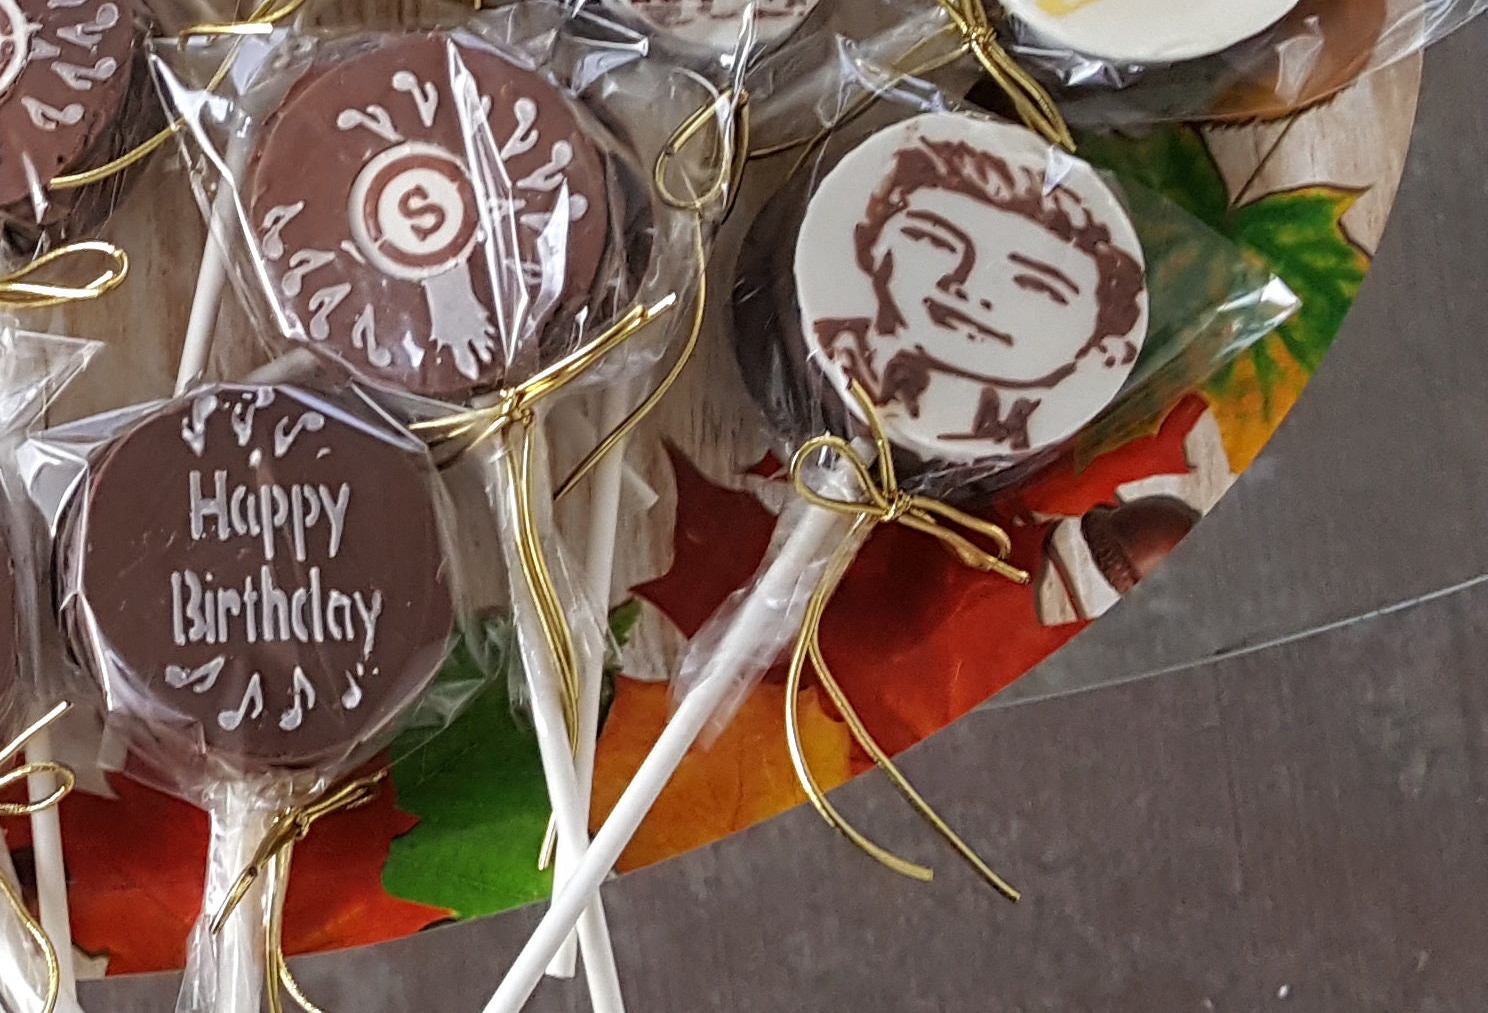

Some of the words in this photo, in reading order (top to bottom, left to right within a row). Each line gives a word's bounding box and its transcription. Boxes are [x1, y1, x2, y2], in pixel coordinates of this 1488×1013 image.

[397, 183, 447, 242] S
[188, 468, 351, 563] Happy
[170, 564, 383, 661] Birthday
